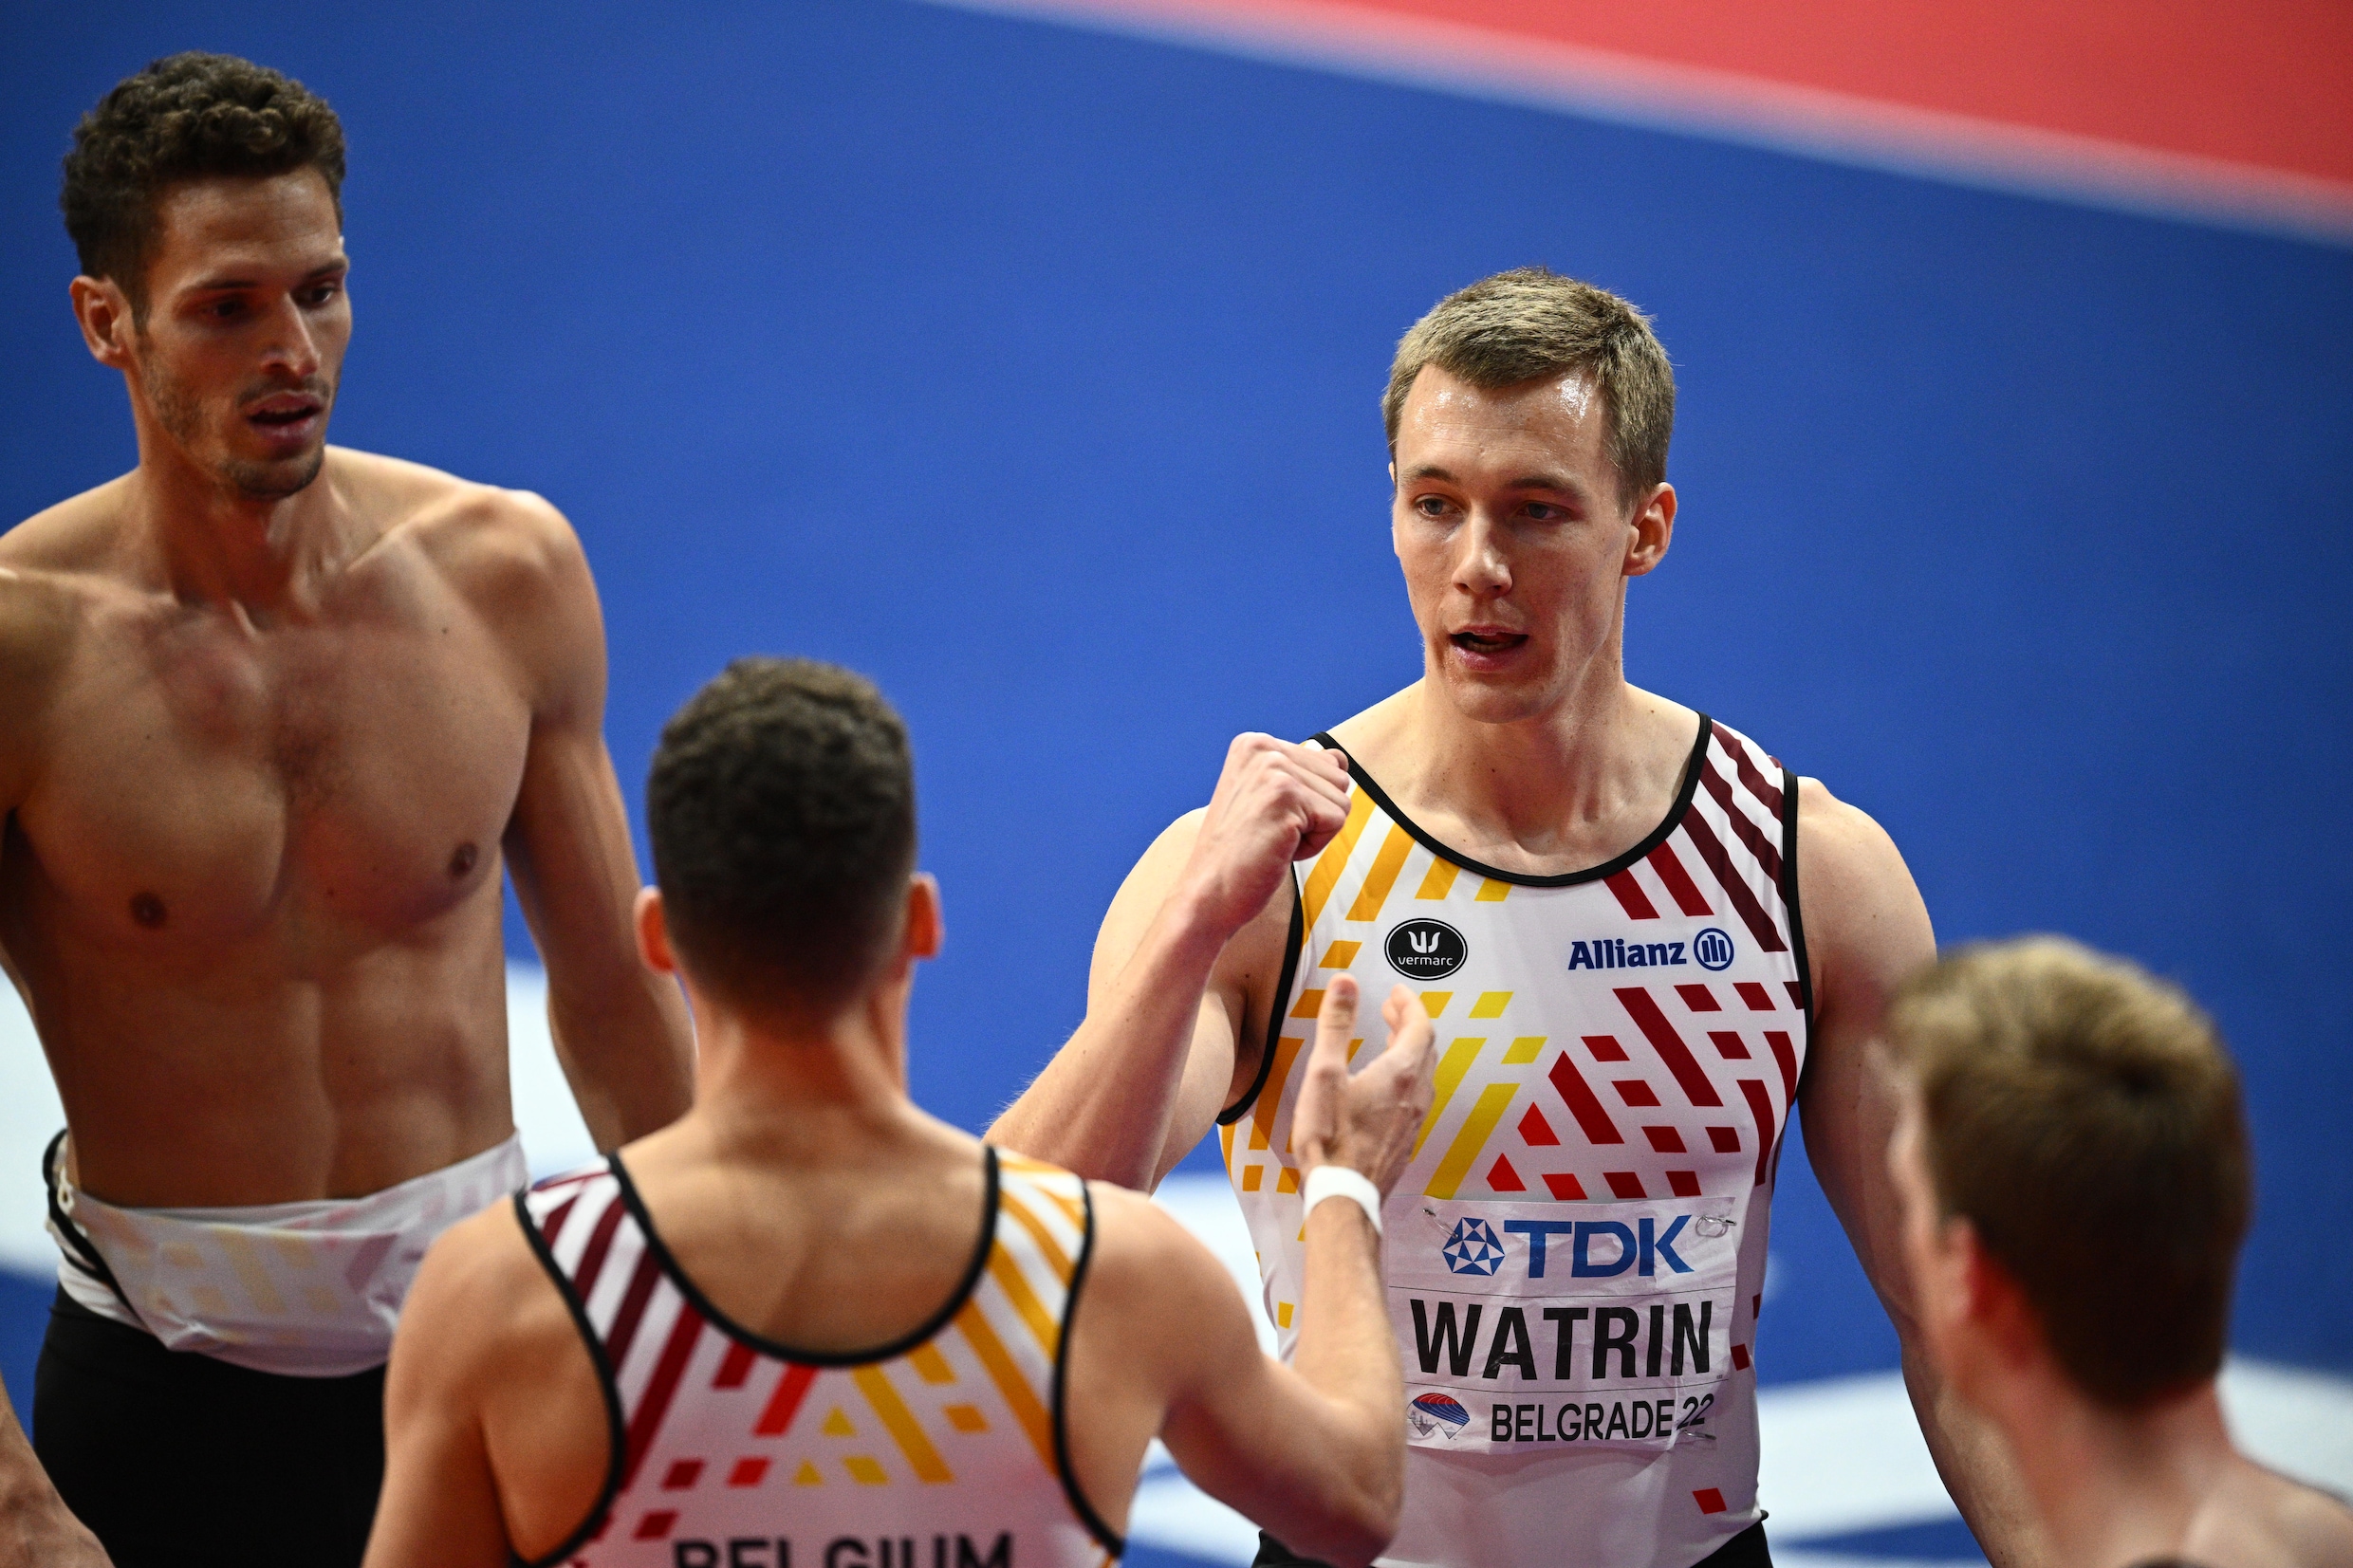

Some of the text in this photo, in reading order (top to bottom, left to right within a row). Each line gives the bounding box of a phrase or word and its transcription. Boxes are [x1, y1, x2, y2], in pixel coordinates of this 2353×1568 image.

[1398, 956, 1454, 967] vermarc
[1567, 938, 1687, 970] Allianz
[1504, 1214, 1695, 1279] TDK
[1410, 1299, 1713, 1380] WATRIN
[1491, 1393, 1714, 1442] BELGRADE 22
